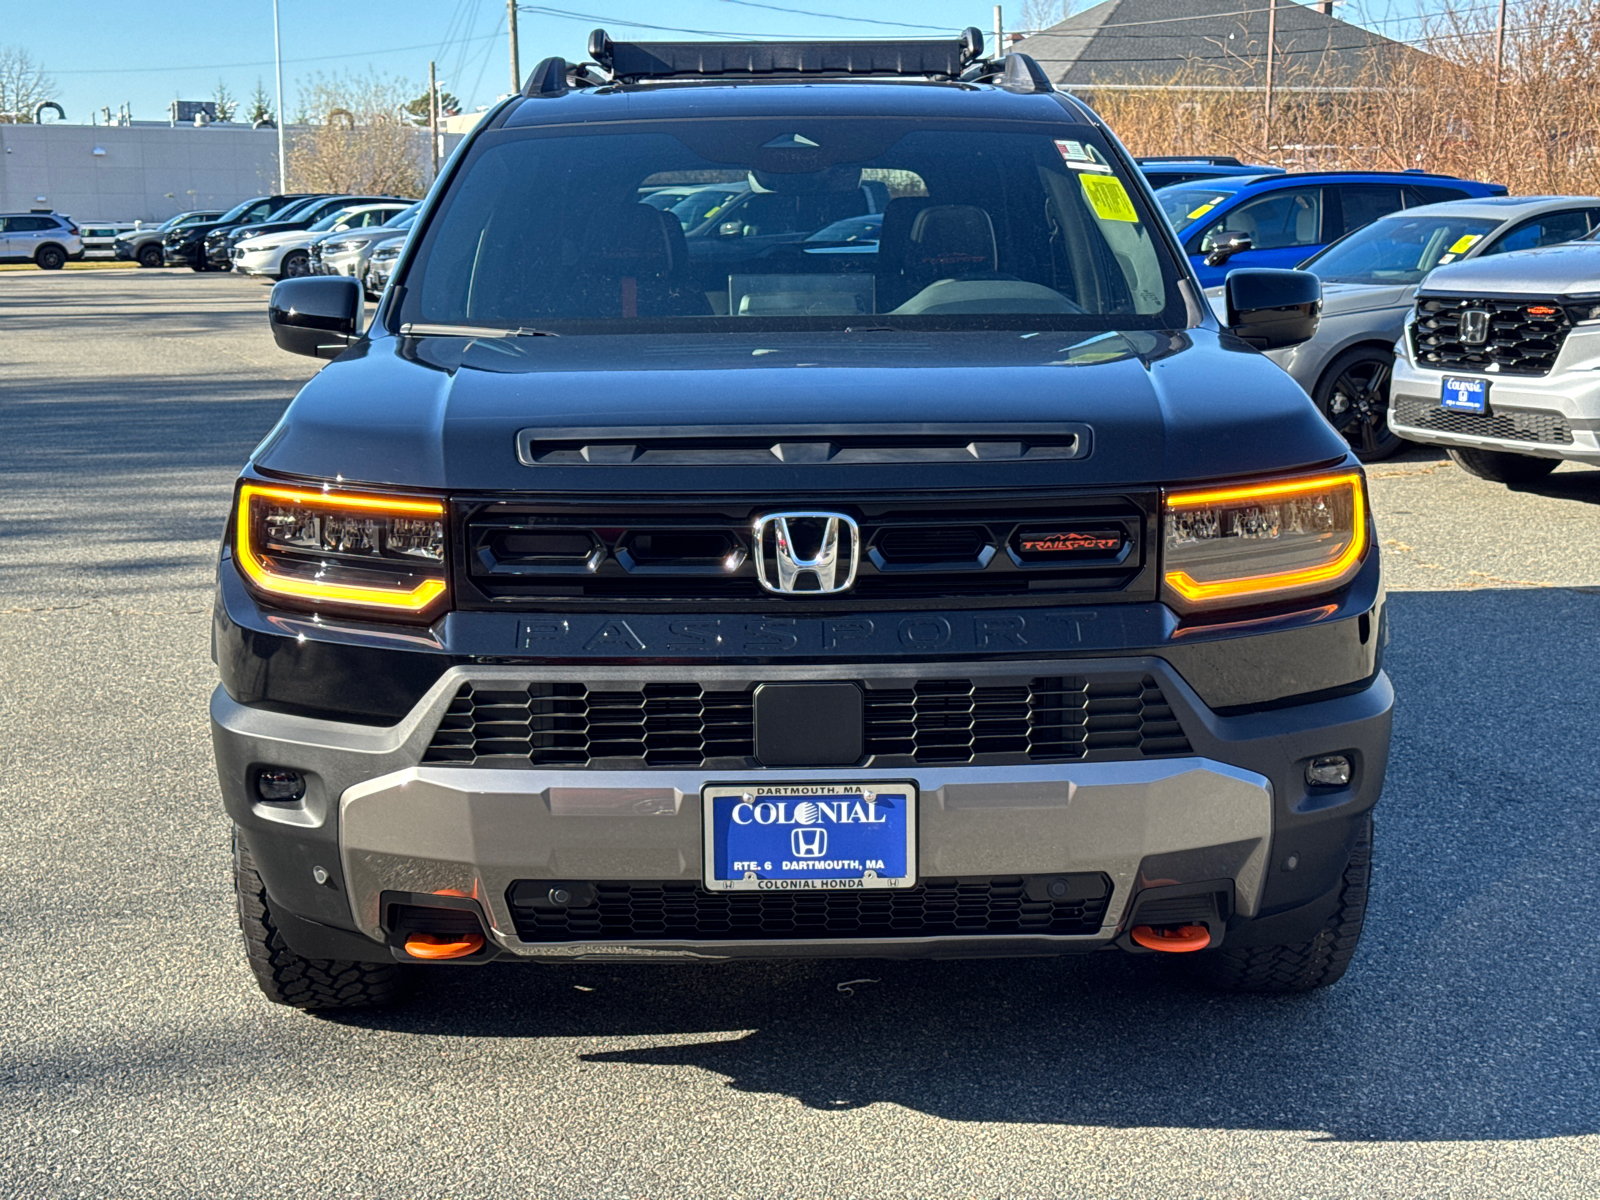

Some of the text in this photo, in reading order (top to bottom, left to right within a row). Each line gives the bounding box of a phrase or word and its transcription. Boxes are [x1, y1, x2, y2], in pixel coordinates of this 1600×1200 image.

[1022, 539, 1118, 551] TRAILSPORT
[515, 611, 1098, 651] PASSPORT
[843, 786, 862, 794] MA
[731, 801, 887, 825] COLONIAL
[733, 859, 885, 871] RTE. 6 DARTMOUTH, MA
[757, 879, 864, 889] COLONIAL HONDA
